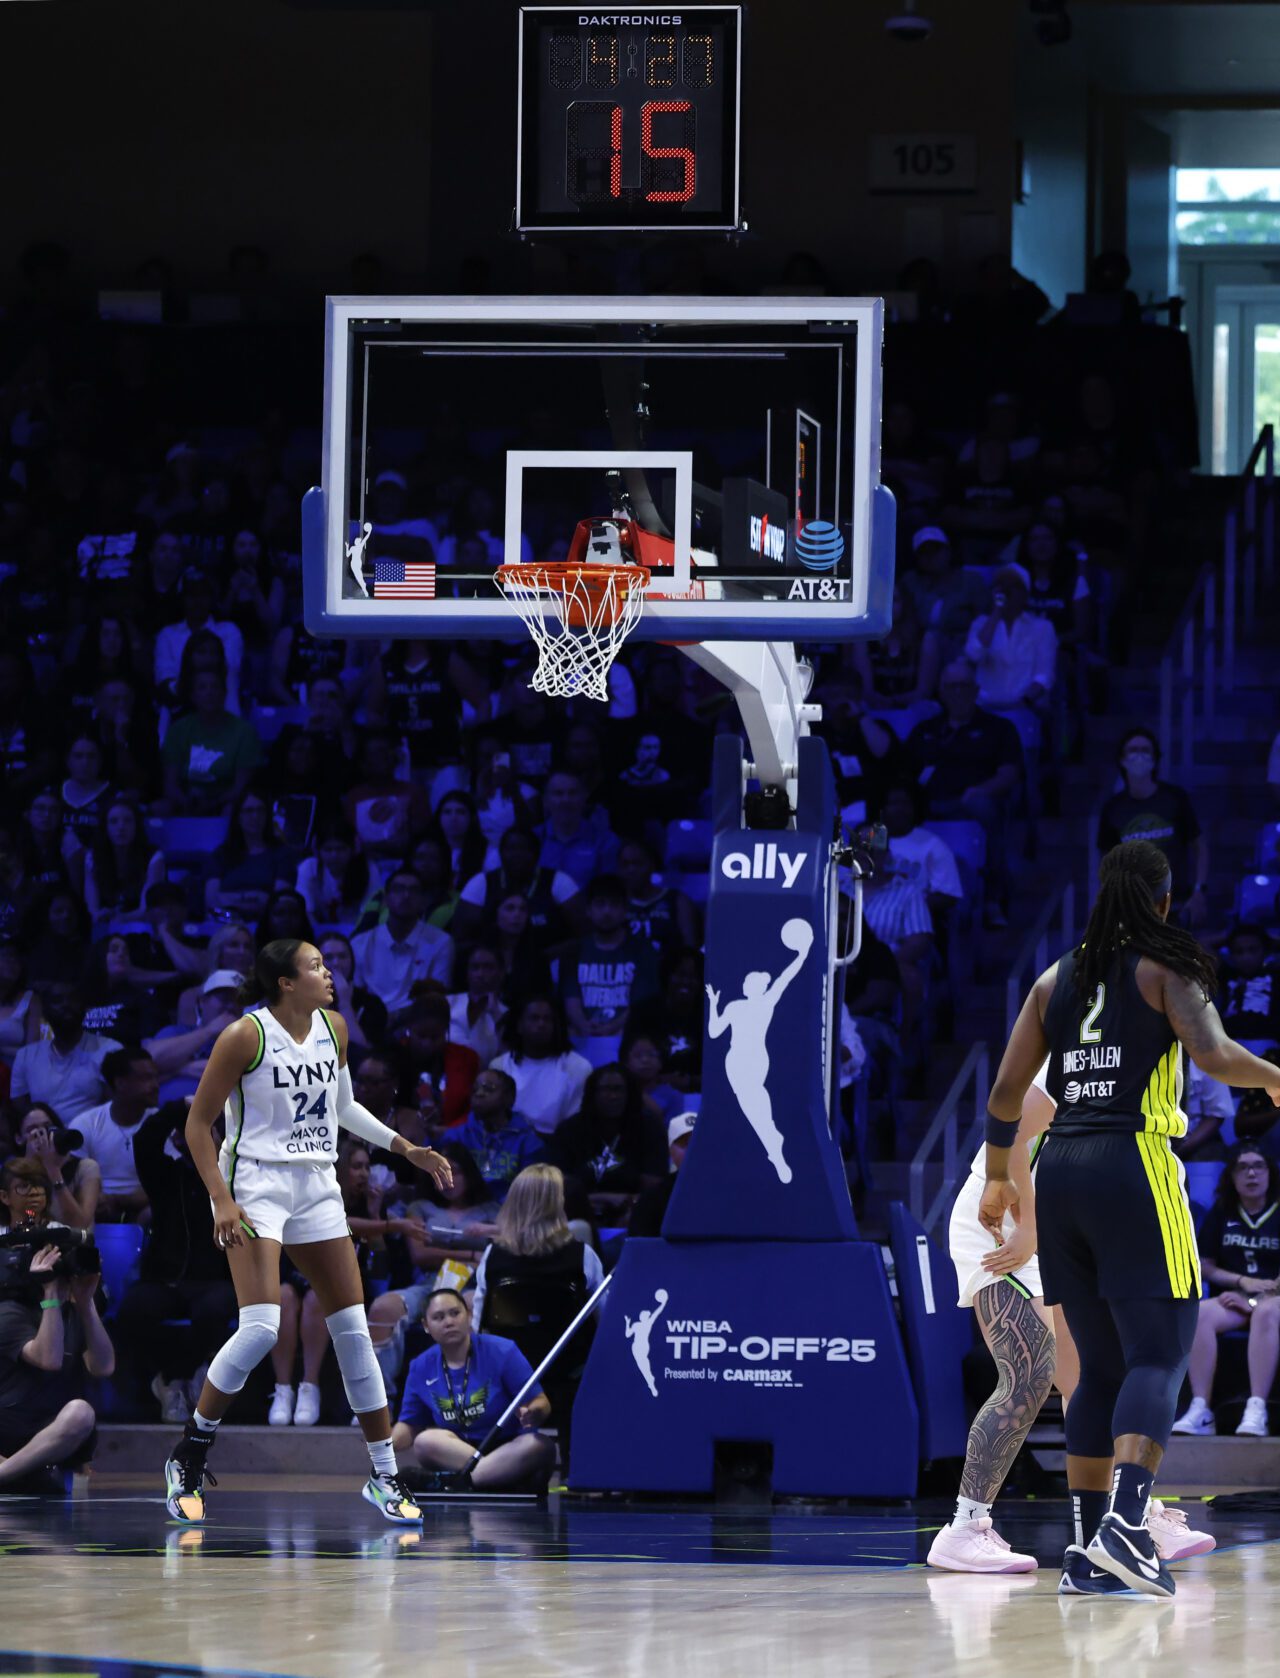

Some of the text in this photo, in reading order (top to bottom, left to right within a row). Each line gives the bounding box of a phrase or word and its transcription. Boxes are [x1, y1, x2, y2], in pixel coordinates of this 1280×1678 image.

[578, 15, 682, 26] DAKTRONICS
[610, 100, 696, 203] 15
[892, 144, 956, 176] 105
[788, 578, 851, 601] AT&T
[721, 843, 808, 889] ally
[577, 961, 636, 985] DALLAS
[1080, 981, 1106, 1044] 2
[1063, 1045, 1121, 1074] HNES-ALLEN
[273, 1059, 337, 1089] LYNX
[1081, 1080, 1117, 1098] AT&T
[292, 1088, 328, 1124] 24
[290, 1126, 329, 1140] MAYO
[286, 1140, 333, 1154] CLINIC
[1221, 1233, 1280, 1249] DALLAS
[1244, 1250, 1259, 1274] 5
[666, 1320, 733, 1334] WNBA
[665, 1335, 877, 1363] TIP-OFF'25
[664, 1367, 706, 1380] Presented
[707, 1368, 718, 1382] by
